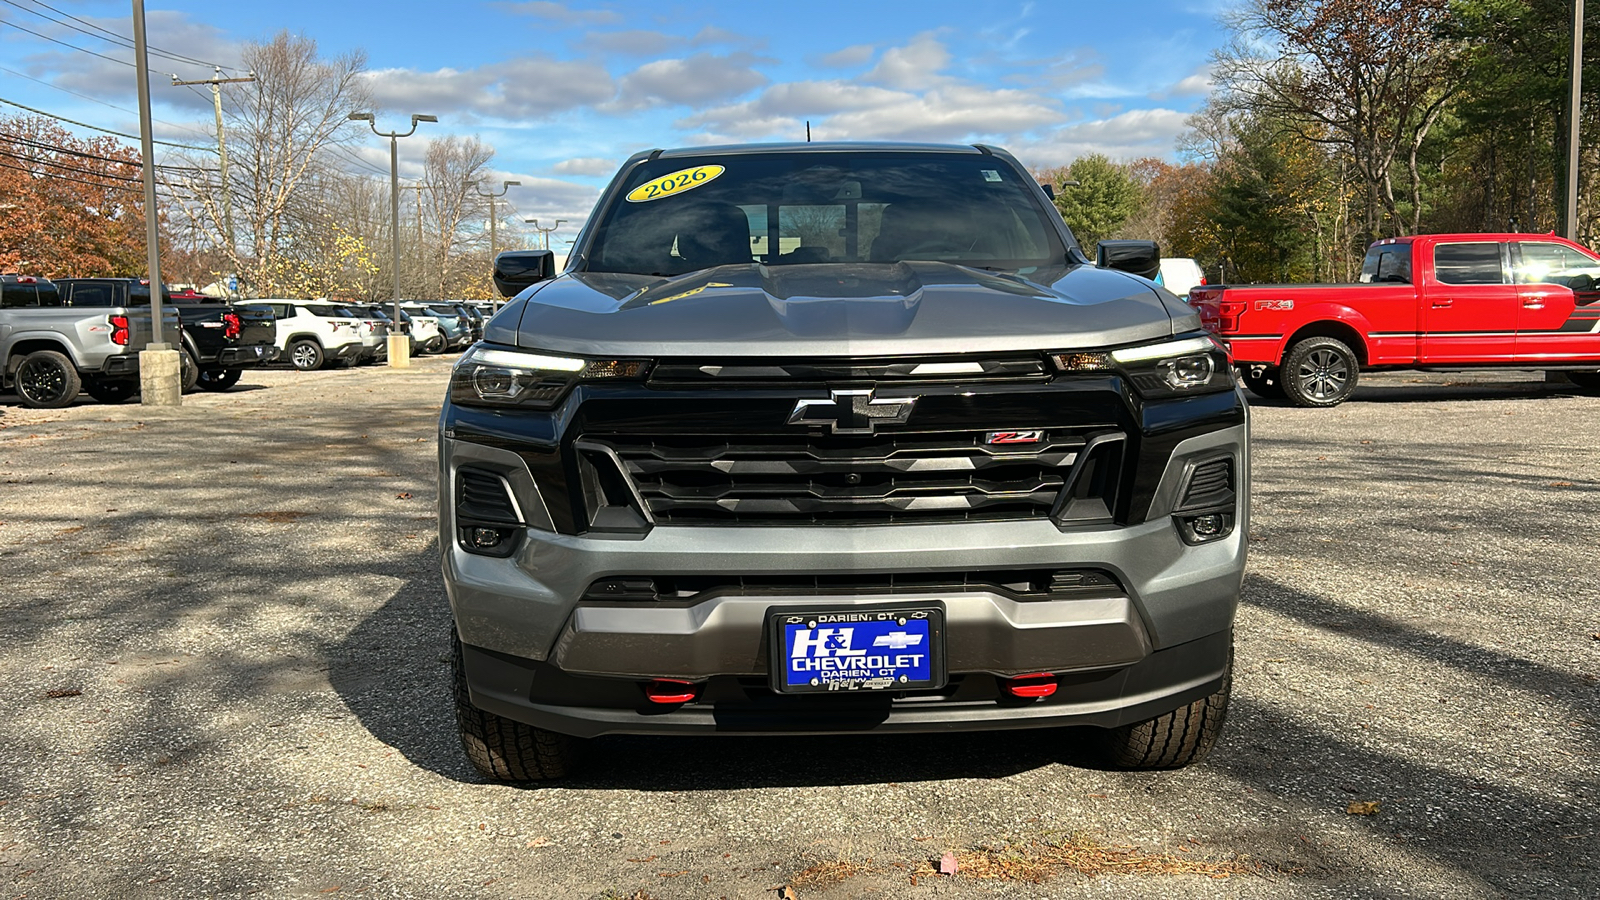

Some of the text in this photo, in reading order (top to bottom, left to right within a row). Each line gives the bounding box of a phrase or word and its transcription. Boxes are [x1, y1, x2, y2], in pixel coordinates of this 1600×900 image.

[645, 168, 707, 199] 2026
[1255, 300, 1294, 311] FX4
[989, 431, 1042, 444] Z71
[818, 612, 898, 623] DARIEN, CT.
[791, 628, 867, 658] H&L
[792, 654, 924, 671] CHEVROLET
[820, 668, 896, 678] DARIEN, CT
